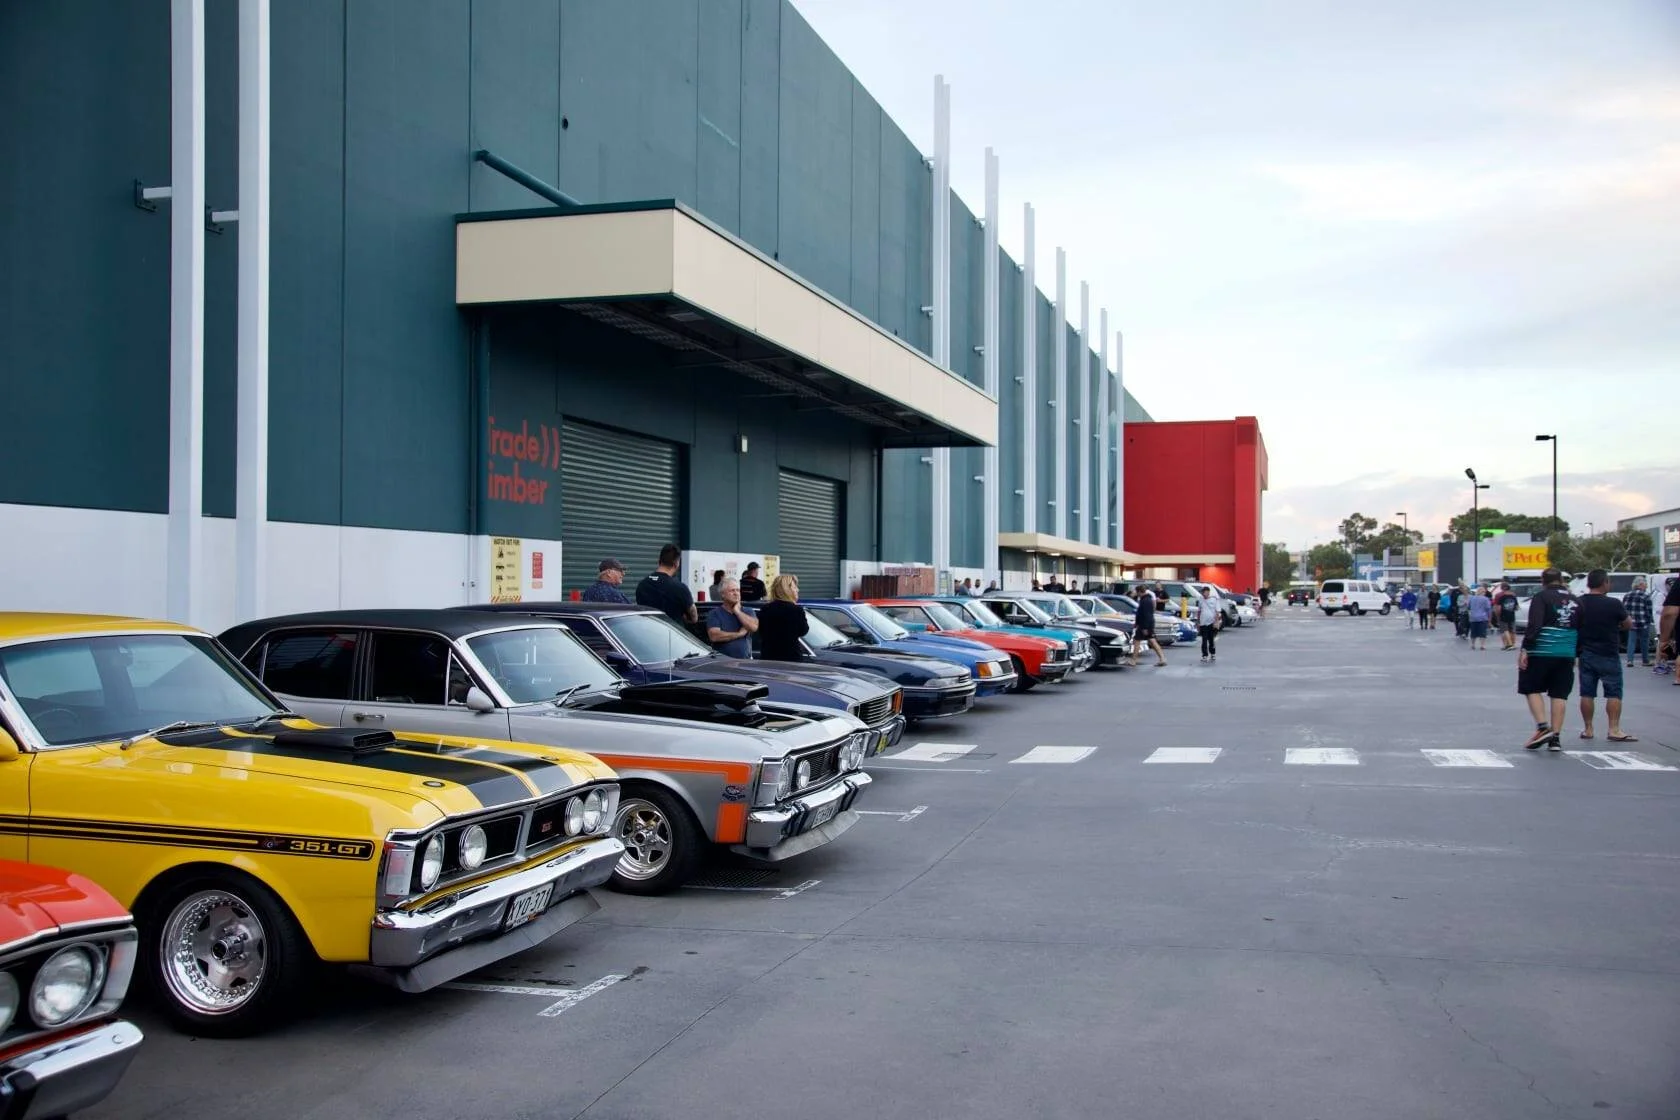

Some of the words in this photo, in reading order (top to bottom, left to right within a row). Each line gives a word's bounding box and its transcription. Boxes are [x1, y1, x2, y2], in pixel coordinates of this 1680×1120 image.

[488, 416, 540, 462] rade
[488, 460, 548, 504] imber
[290, 840, 366, 855] 351-GT
